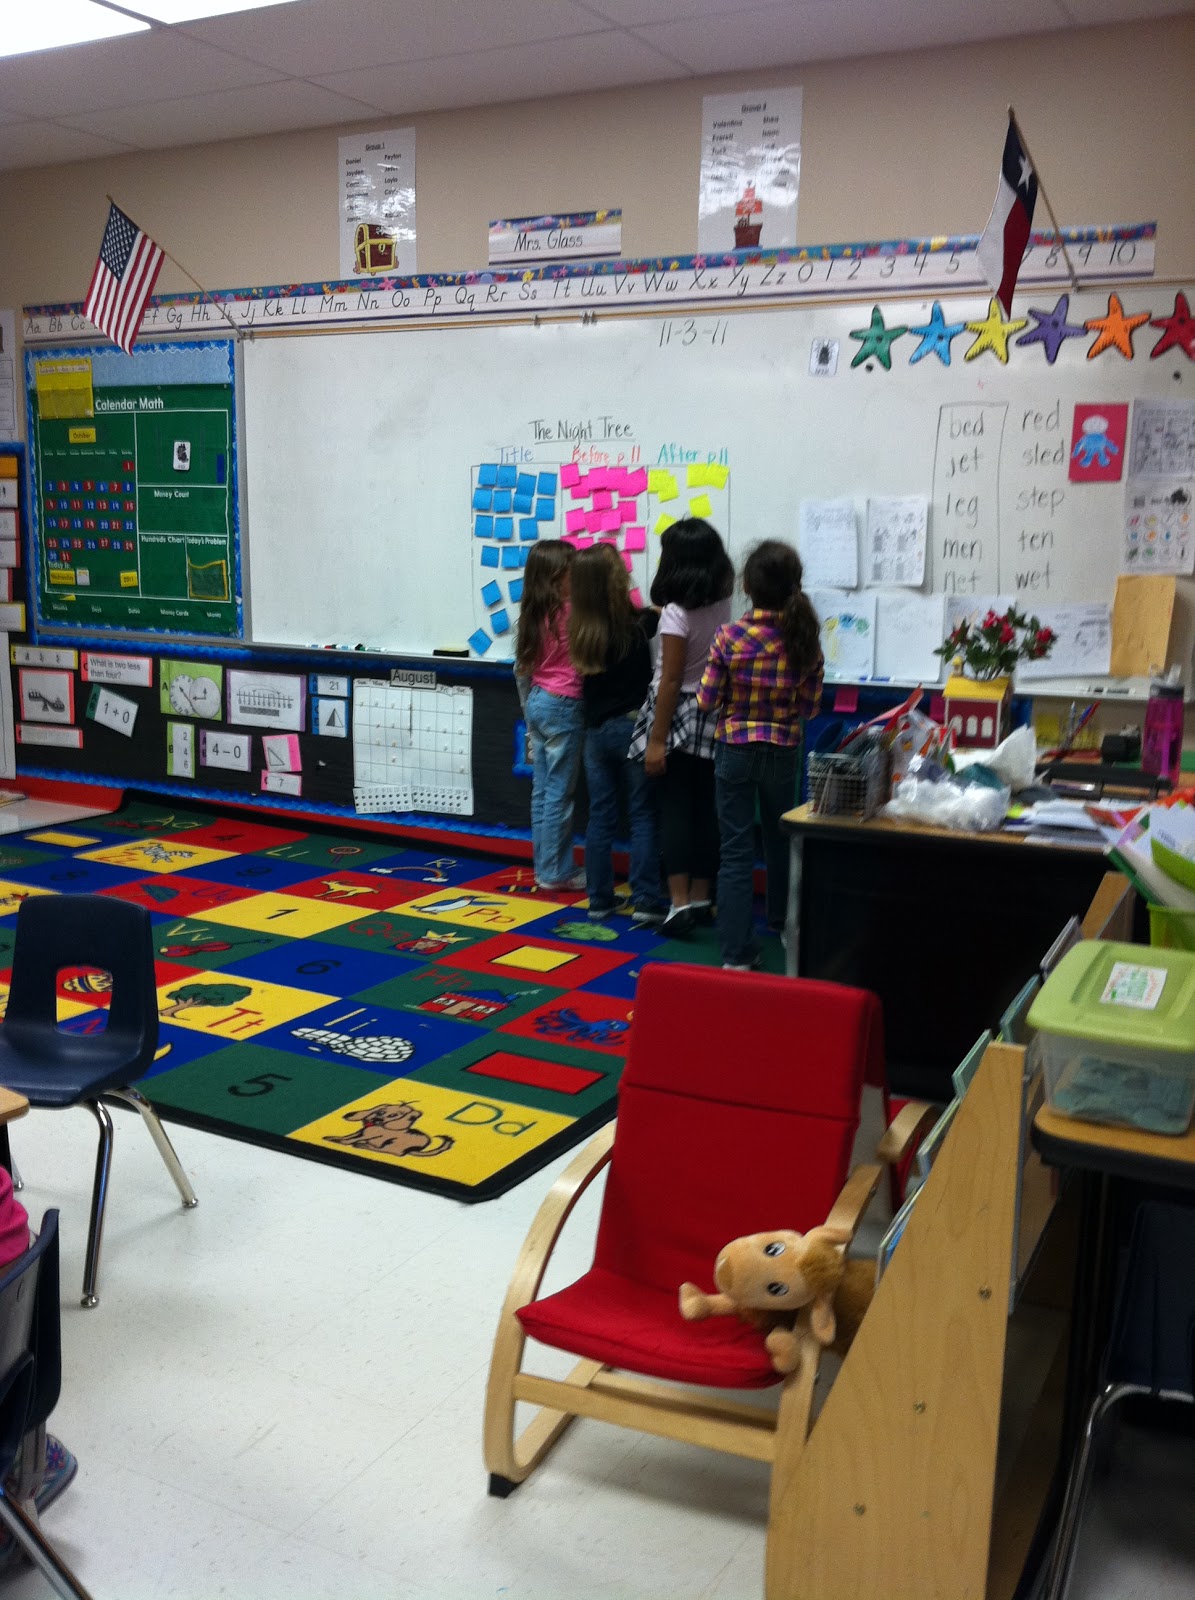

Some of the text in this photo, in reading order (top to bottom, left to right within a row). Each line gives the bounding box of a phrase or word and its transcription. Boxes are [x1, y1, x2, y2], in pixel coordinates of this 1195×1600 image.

[514, 229, 583, 252] Mrs. Glass
[26, 317, 41, 334] Aa
[49, 315, 62, 333] Bb
[71, 316, 86, 330] Cc
[167, 306, 182, 330] Gg
[191, 305, 210, 321] Hh
[241, 301, 256, 325] Jj
[263, 299, 283, 317] Kk
[292, 297, 306, 315] Ll
[320, 295, 347, 313] Mm
[357, 293, 379, 310] Nn
[392, 290, 410, 308] Oo
[424, 288, 442, 313] Pp
[455, 286, 475, 311] Qq
[486, 284, 508, 303] Rr
[519, 283, 537, 301] Ss
[553, 278, 571, 298] Tt
[581, 277, 606, 297] Uu
[614, 275, 635, 294] Vv
[644, 272, 679, 292] Ww
[689, 266, 717, 290] Xx
[728, 266, 750, 297] Yy
[760, 264, 786, 286] Zz
[798, 261, 814, 283] 0
[826, 259, 834, 281] 1
[847, 257, 862, 280] 2
[880, 255, 896, 278] 3
[914, 252, 928, 276] 4
[945, 250, 962, 274] 5
[1045, 246, 1061, 268] 8
[1078, 243, 1093, 266] 9
[1109, 240, 1136, 265] 10
[95, 396, 164, 411] Calendar Math
[1022, 398, 1060, 431] red
[528, 416, 633, 449] The Night Tree
[950, 408, 984, 439] bed
[496, 445, 534, 463] Title
[572, 444, 610, 465] Before
[658, 442, 698, 464] After
[946, 446, 983, 478] jet
[1023, 439, 1064, 466] sled
[946, 492, 978, 529] leg
[1016, 486, 1065, 518] step
[942, 538, 982, 562] men
[1018, 530, 1053, 551] ten
[944, 569, 980, 594] net
[1015, 561, 1054, 590] wet
[90, 658, 107, 667] What
[114, 661, 126, 669] two
[127, 662, 141, 670] less
[90, 670, 121, 679] than four?
[329, 681, 339, 690] 21
[393, 670, 434, 686] August
[183, 732, 188, 741] 2
[184, 748, 188, 756] 4
[212, 743, 219, 756] 4
[233, 746, 241, 759] 0
[279, 778, 284, 787] 7
[463, 908, 516, 923] Pp
[166, 923, 215, 942] Vv
[206, 1007, 266, 1034] Tt
[227, 1073, 293, 1097] 5
[445, 1101, 537, 1137] Dd
